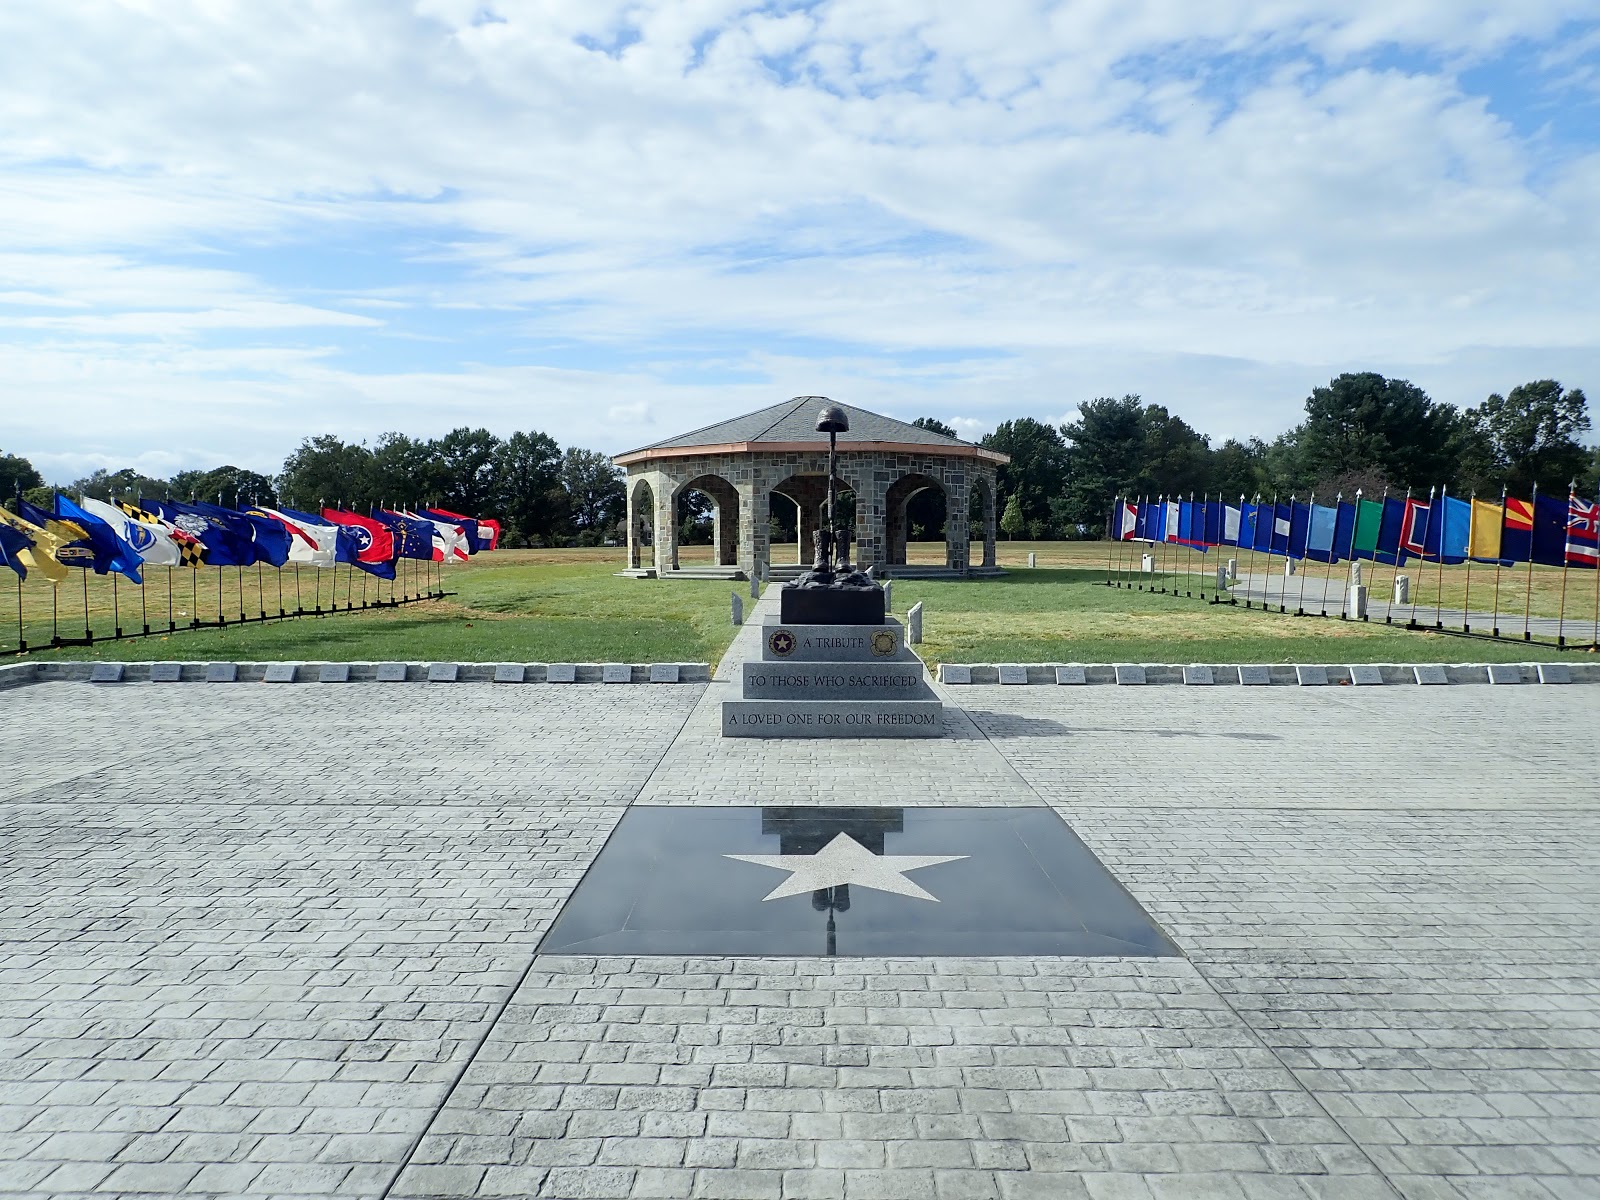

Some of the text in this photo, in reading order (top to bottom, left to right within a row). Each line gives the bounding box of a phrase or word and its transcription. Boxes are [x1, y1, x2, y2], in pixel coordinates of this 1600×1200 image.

[803, 638, 864, 648] A TRIBUTE
[749, 676, 917, 686] TO THOSE WHO SACRIFICED
[729, 714, 935, 725] A LOVED ONE FOR OUR FREEDOM
